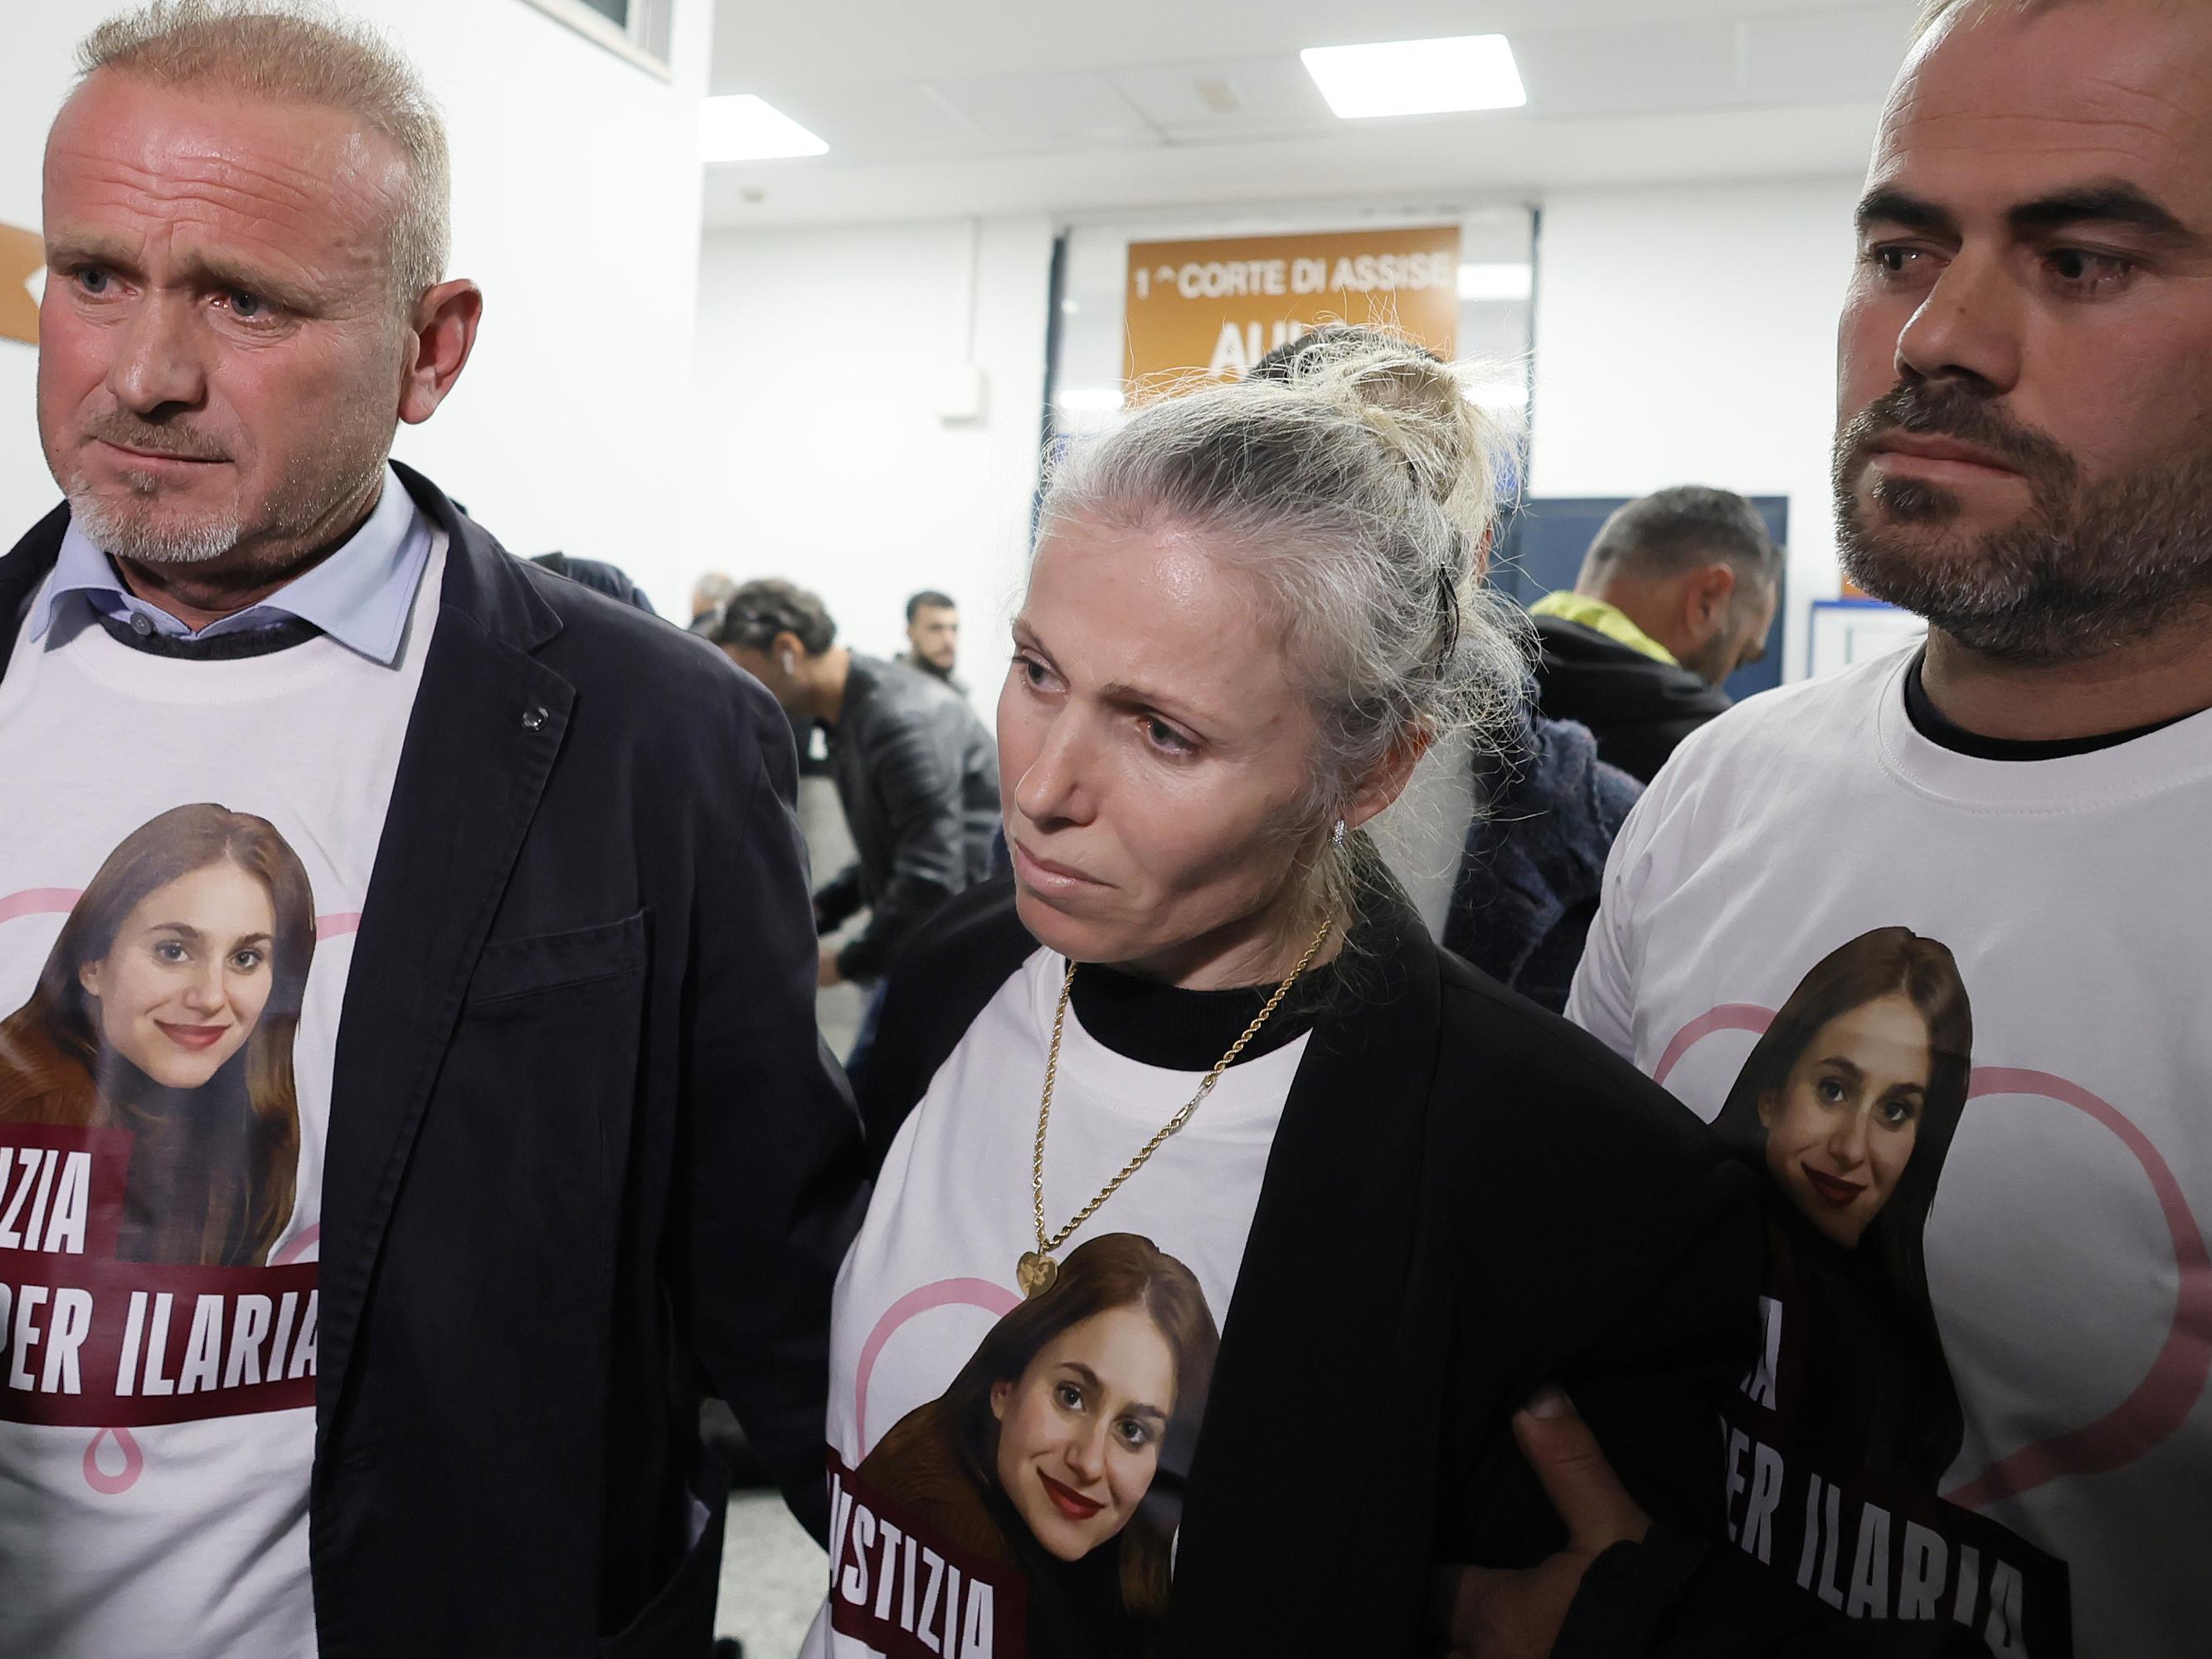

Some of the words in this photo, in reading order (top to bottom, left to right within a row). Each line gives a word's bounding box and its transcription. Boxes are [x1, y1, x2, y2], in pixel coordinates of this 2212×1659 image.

[1177, 259, 1286, 299] CORTE
[1291, 257, 1326, 294] DI
[1330, 252, 1452, 292] ASSISE
[1719, 1413, 1784, 1566] ER
[1796, 1473, 2029, 1659] ILARIA
